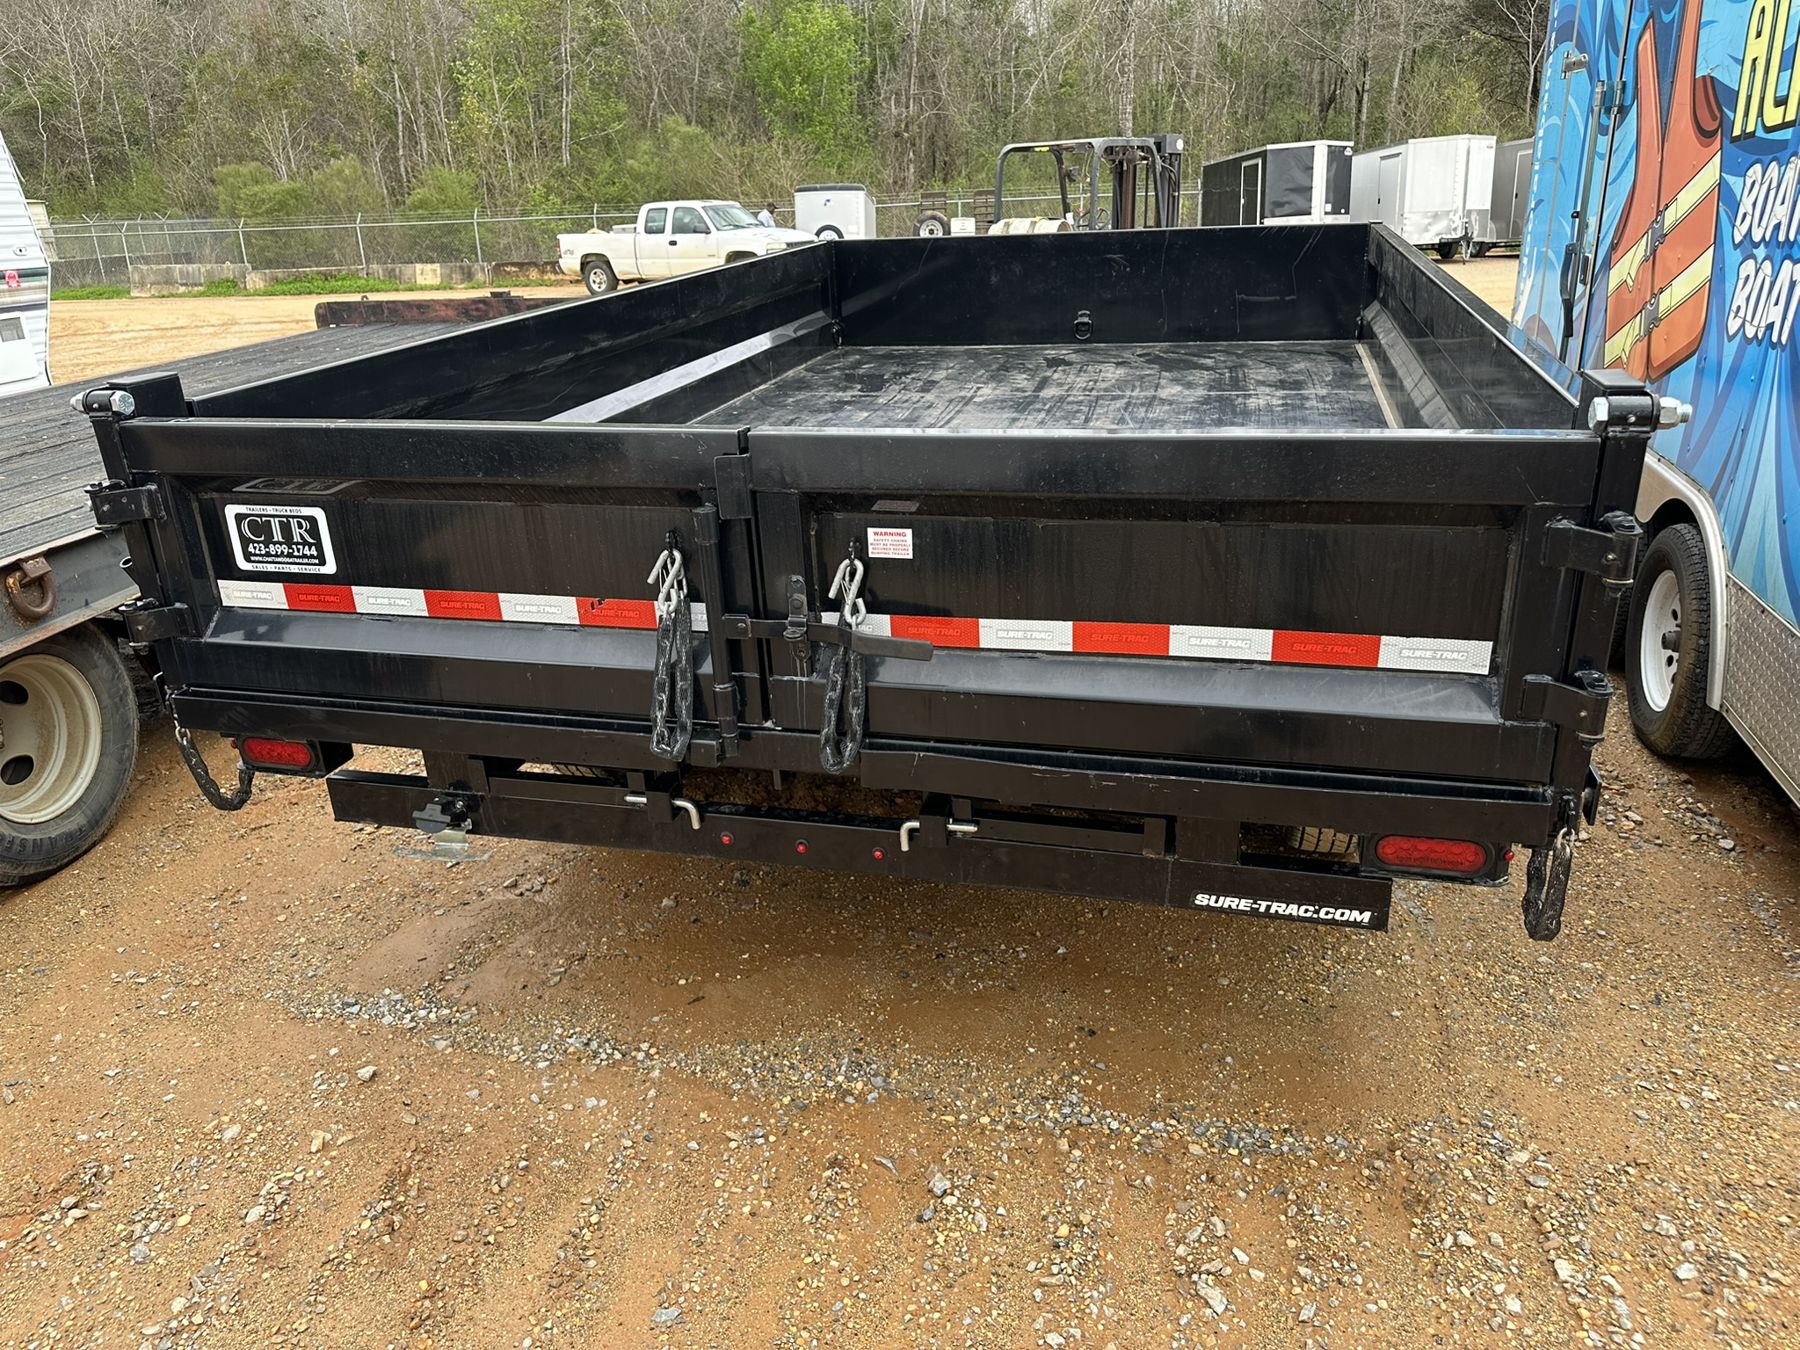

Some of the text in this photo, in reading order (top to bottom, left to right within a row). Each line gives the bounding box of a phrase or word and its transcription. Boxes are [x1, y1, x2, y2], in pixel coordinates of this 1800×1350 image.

[241, 516, 317, 543] CTR
[248, 542, 318, 557] 423-899-1744
[367, 597, 411, 607] SURE-TRAC
[439, 600, 485, 610] SURE-TRAC
[515, 604, 562, 614] SURE-TRAC
[593, 608, 640, 617] SURE-TRAC
[908, 626, 961, 637] SURE-TRAC
[997, 629, 1053, 641] SURE-TRAC
[1091, 632, 1150, 643] SURE-TRAC
[1188, 636, 1251, 649] SURE-TRAC
[1292, 642, 1358, 654] SURE-TRAC
[1400, 648, 1468, 661] SURE-TRAC
[1194, 892, 1372, 923] SURE-TRAC.COM
